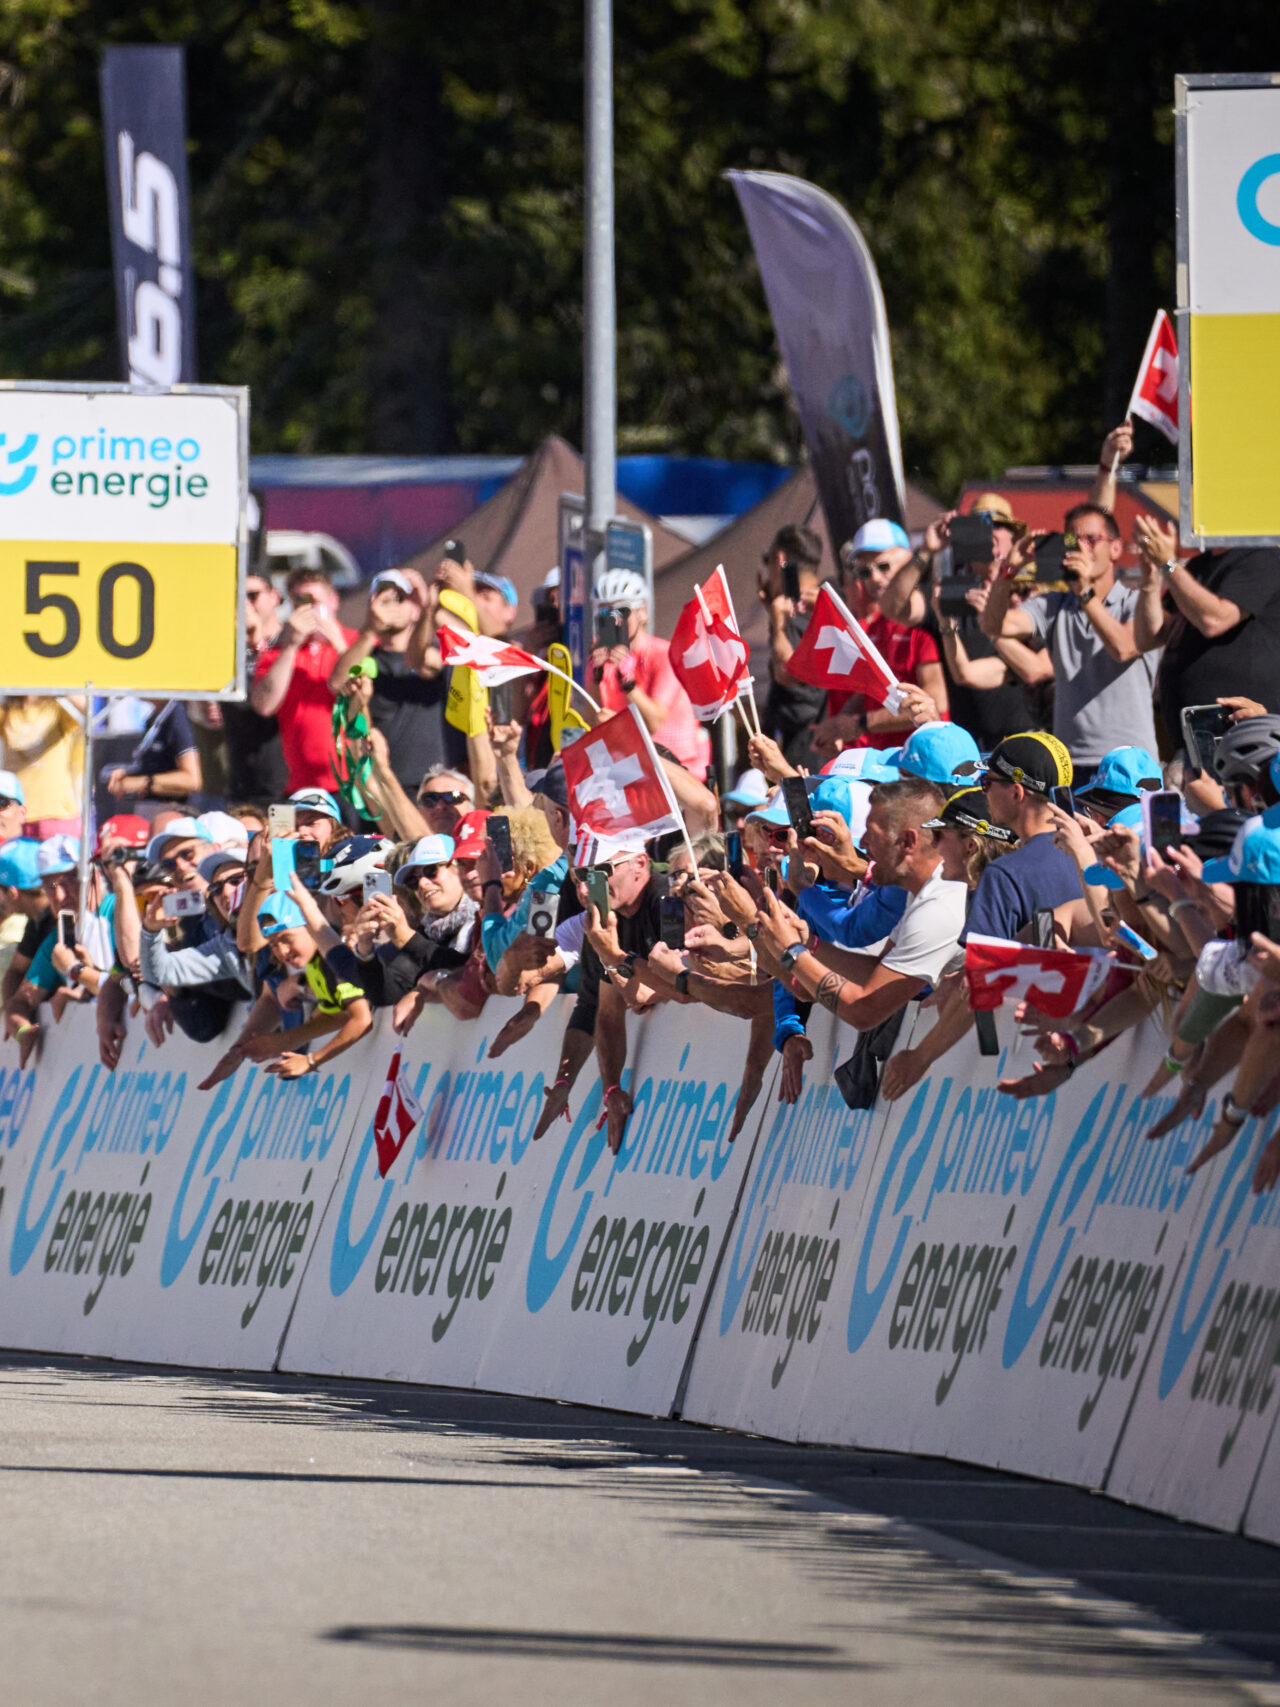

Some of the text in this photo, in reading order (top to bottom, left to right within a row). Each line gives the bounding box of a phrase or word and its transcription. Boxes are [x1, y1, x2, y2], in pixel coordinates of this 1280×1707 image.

[116, 129, 183, 385] 6.5
[51, 465, 209, 509] energie
[52, 427, 201, 466] primeo
[22, 559, 156, 660] 50
[75, 1040, 188, 1174] primeo
[229, 1072, 351, 1183] primeo
[404, 1036, 546, 1186] primeo
[603, 1042, 740, 1198] primeo
[773, 1044, 872, 1212] primeo
[923, 1047, 1057, 1222] primeo
[43, 1161, 153, 1317] energie
[198, 1167, 315, 1330] energie
[374, 1171, 513, 1344] energie
[570, 1187, 711, 1368] energie
[741, 1198, 841, 1390] energie
[1039, 1222, 1166, 1432] energie
